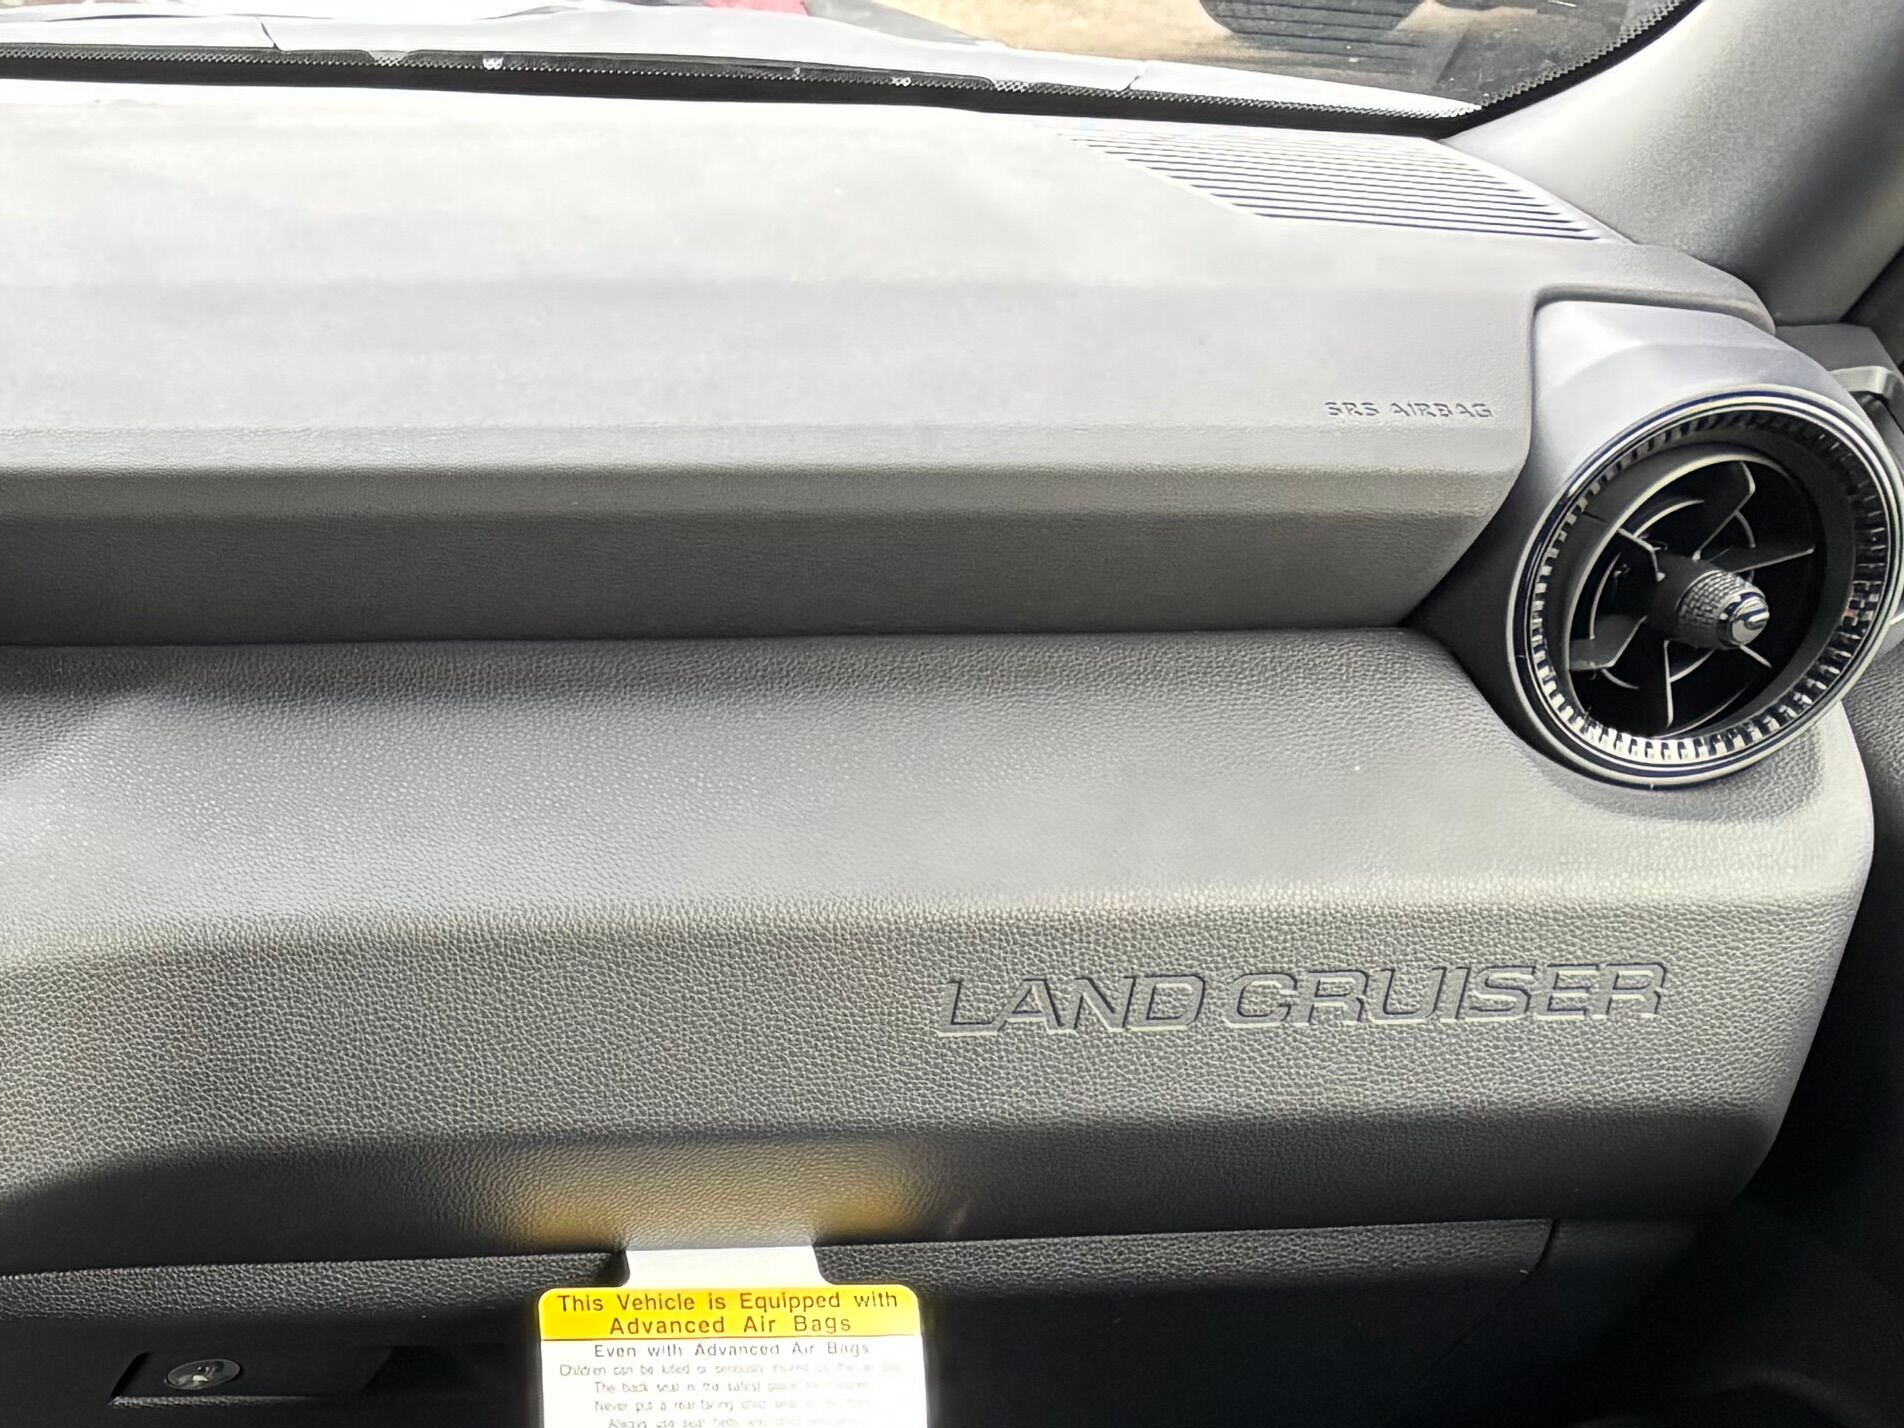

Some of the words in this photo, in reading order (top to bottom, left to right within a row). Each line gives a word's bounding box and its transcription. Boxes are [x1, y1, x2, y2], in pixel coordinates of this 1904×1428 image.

[1324, 401, 1380, 416] SRS
[1391, 402, 1494, 418] AIRBAG
[936, 972, 1207, 1038] LAND
[1224, 962, 1667, 1030] CRUISER
[557, 1293, 605, 1312] This
[616, 1292, 695, 1312] Vehicle
[708, 1292, 726, 1311] is
[739, 1291, 842, 1313] Equipped
[853, 1291, 899, 1309] with
[609, 1315, 725, 1335] Advanced
[742, 1315, 777, 1333] Air
[793, 1315, 852, 1335] Bags
[594, 1344, 637, 1358] Even
[647, 1343, 683, 1358] with
[694, 1342, 780, 1357] Advanced
[791, 1341, 815, 1355] Air
[827, 1340, 870, 1358] Bags
